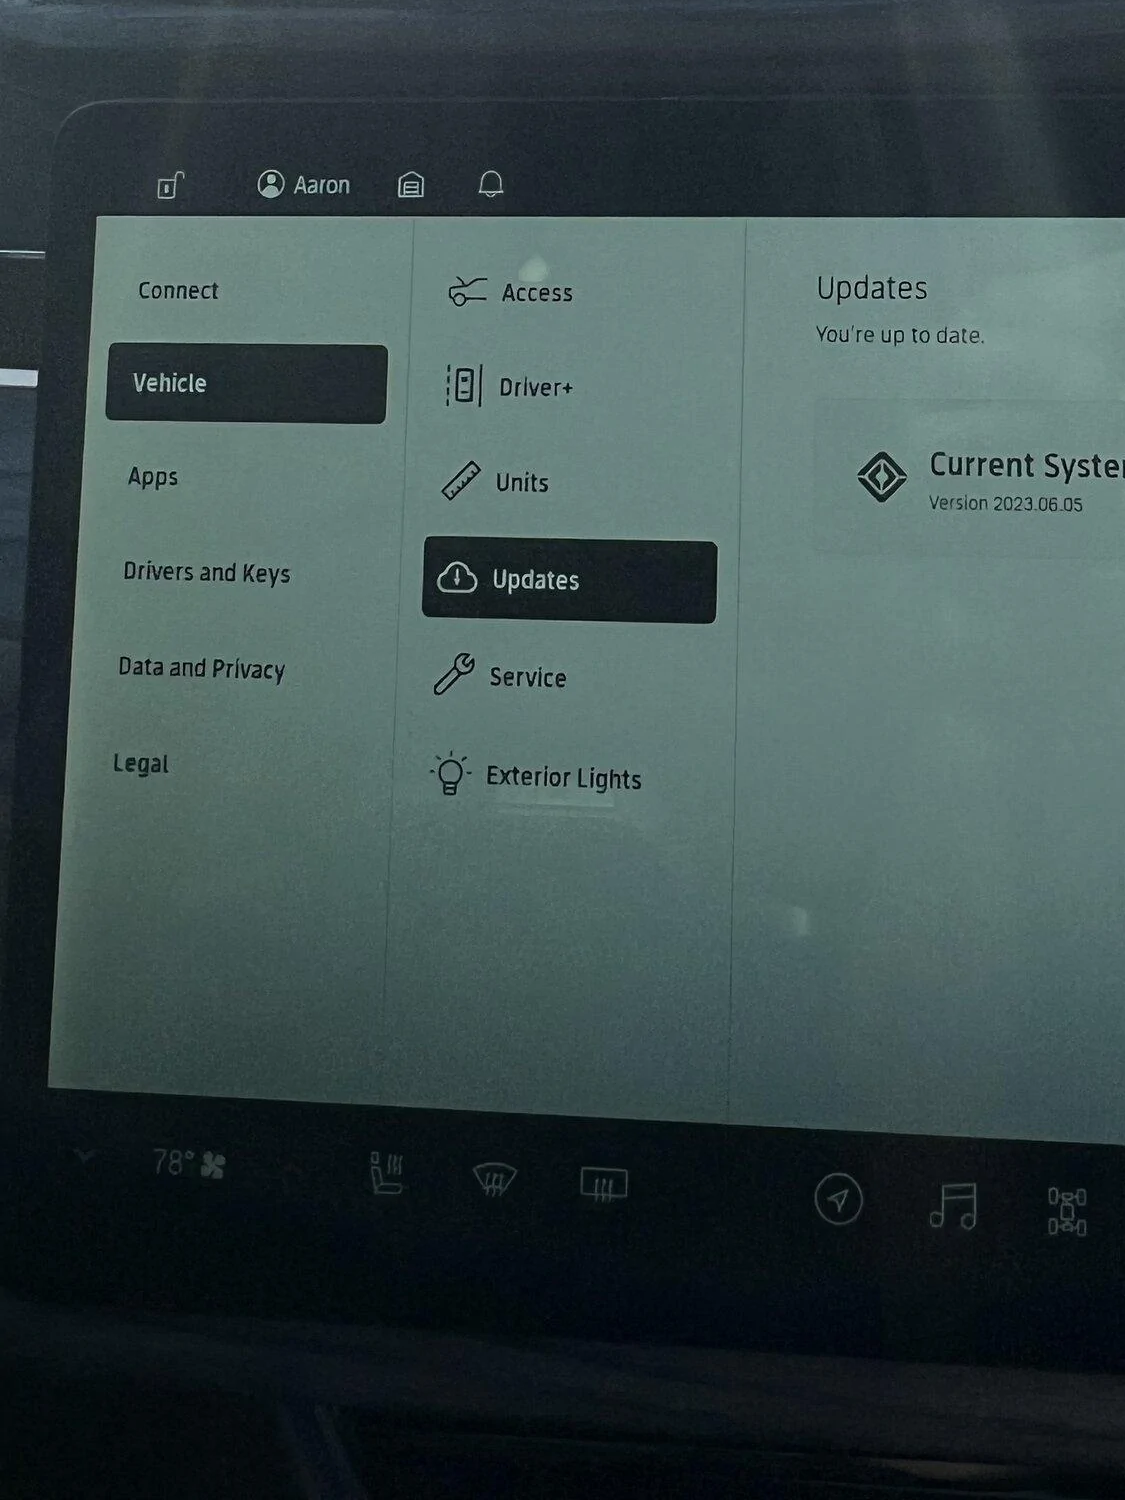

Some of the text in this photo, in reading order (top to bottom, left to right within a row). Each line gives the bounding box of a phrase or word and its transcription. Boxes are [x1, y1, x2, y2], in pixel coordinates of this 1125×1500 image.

[293, 175, 350, 195] Aaron
[139, 281, 219, 300] Connect
[501, 283, 573, 302] Access
[818, 274, 928, 306] Updates
[816, 325, 985, 347] You're up to date.
[133, 372, 207, 393] Vehicle
[500, 376, 573, 397] Driver+
[930, 451, 1035, 478] Current
[127, 466, 178, 491] Apps
[496, 471, 549, 493] Units
[928, 494, 1083, 513] Version 2023.06.05
[124, 560, 291, 589] Drivers and Keys
[493, 568, 580, 595] Updates
[119, 656, 286, 686] Data and Privacy
[490, 666, 567, 688] Service
[113, 753, 169, 778] Legal
[486, 765, 642, 794] Exterior Lights
